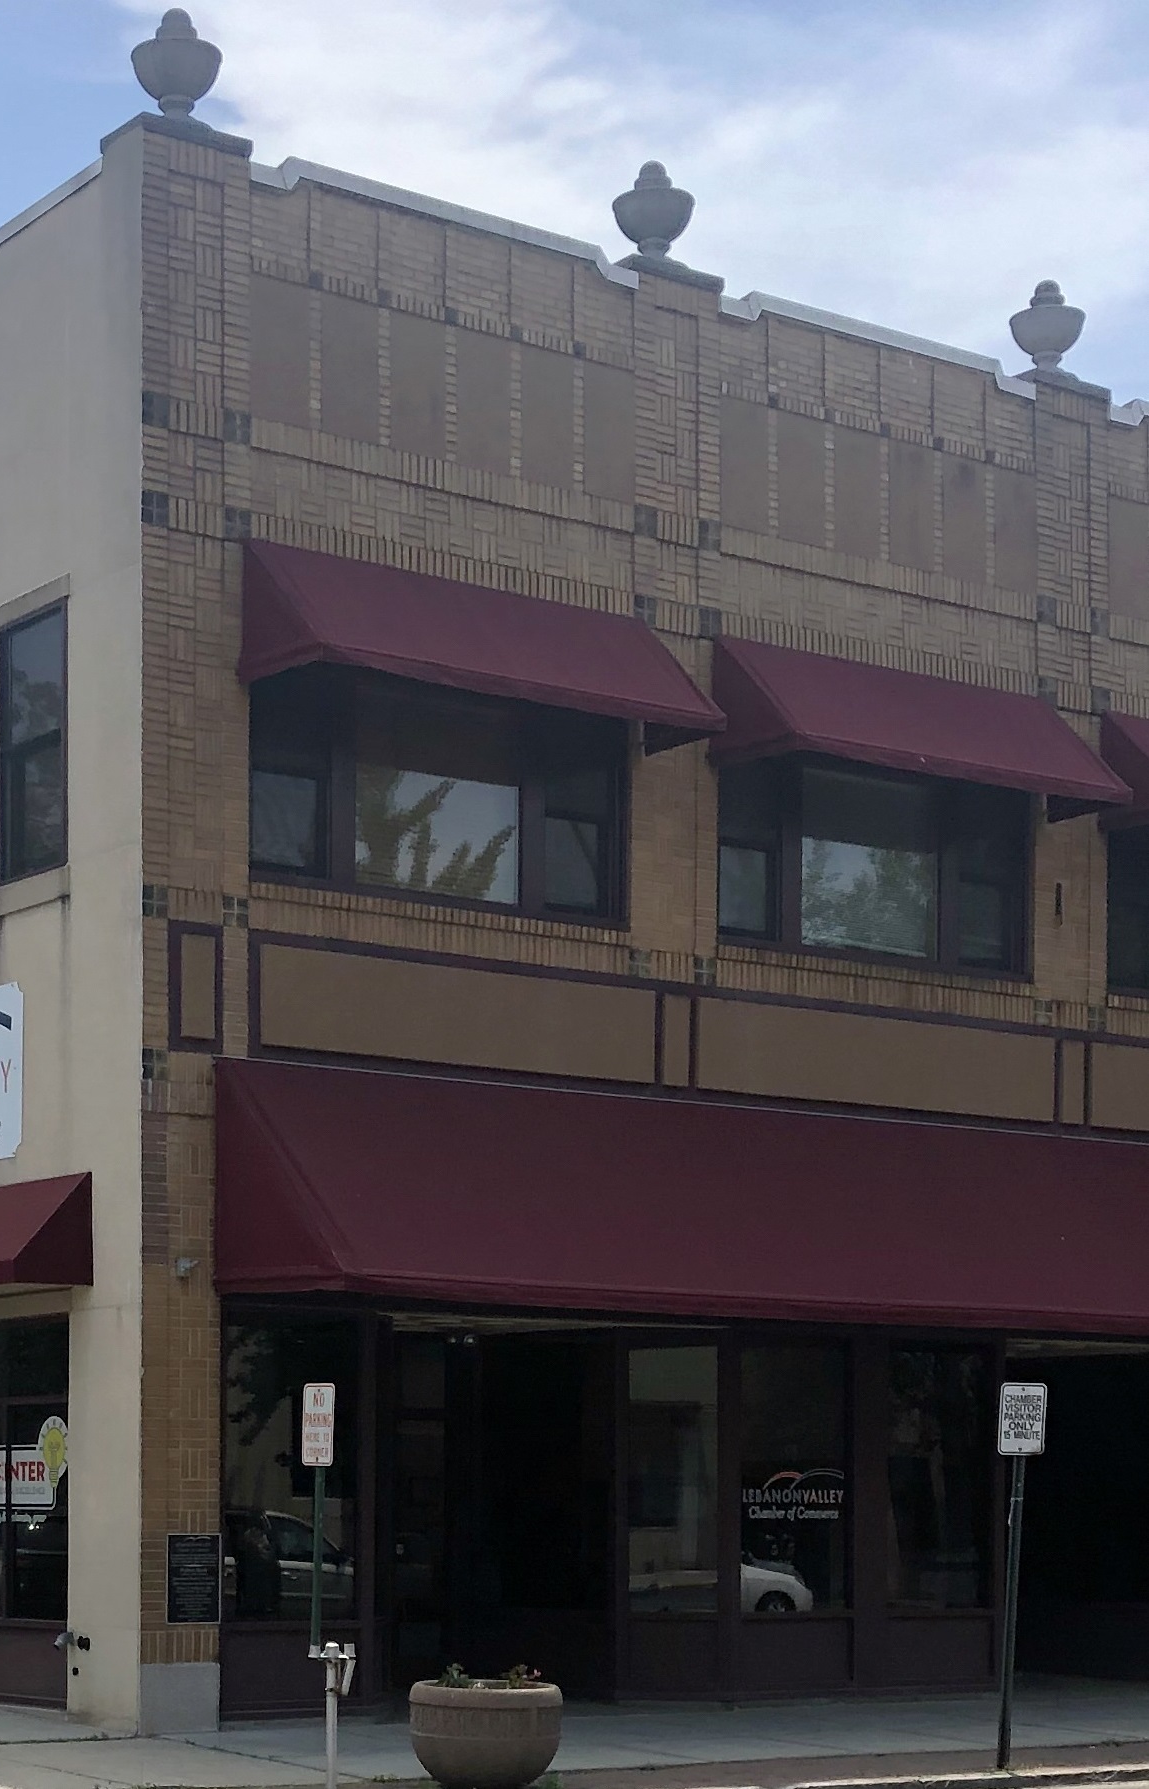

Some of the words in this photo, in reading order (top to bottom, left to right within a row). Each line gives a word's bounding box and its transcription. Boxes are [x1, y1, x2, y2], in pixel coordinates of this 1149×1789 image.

[312, 1392, 325, 1407] NO
[1004, 1394, 1042, 1404] CHAMBER
[1004, 1403, 1042, 1413] VISITOR
[304, 1413, 332, 1428] PARKING
[1004, 1412, 1041, 1422] PARKING
[1008, 1421, 1035, 1431] ONLY
[1013, 1430, 1041, 1440] MINUTE
[748, 1505, 785, 1519] Chamber
[786, 1506, 797, 1521] of
[797, 1506, 839, 1519] Commerce
